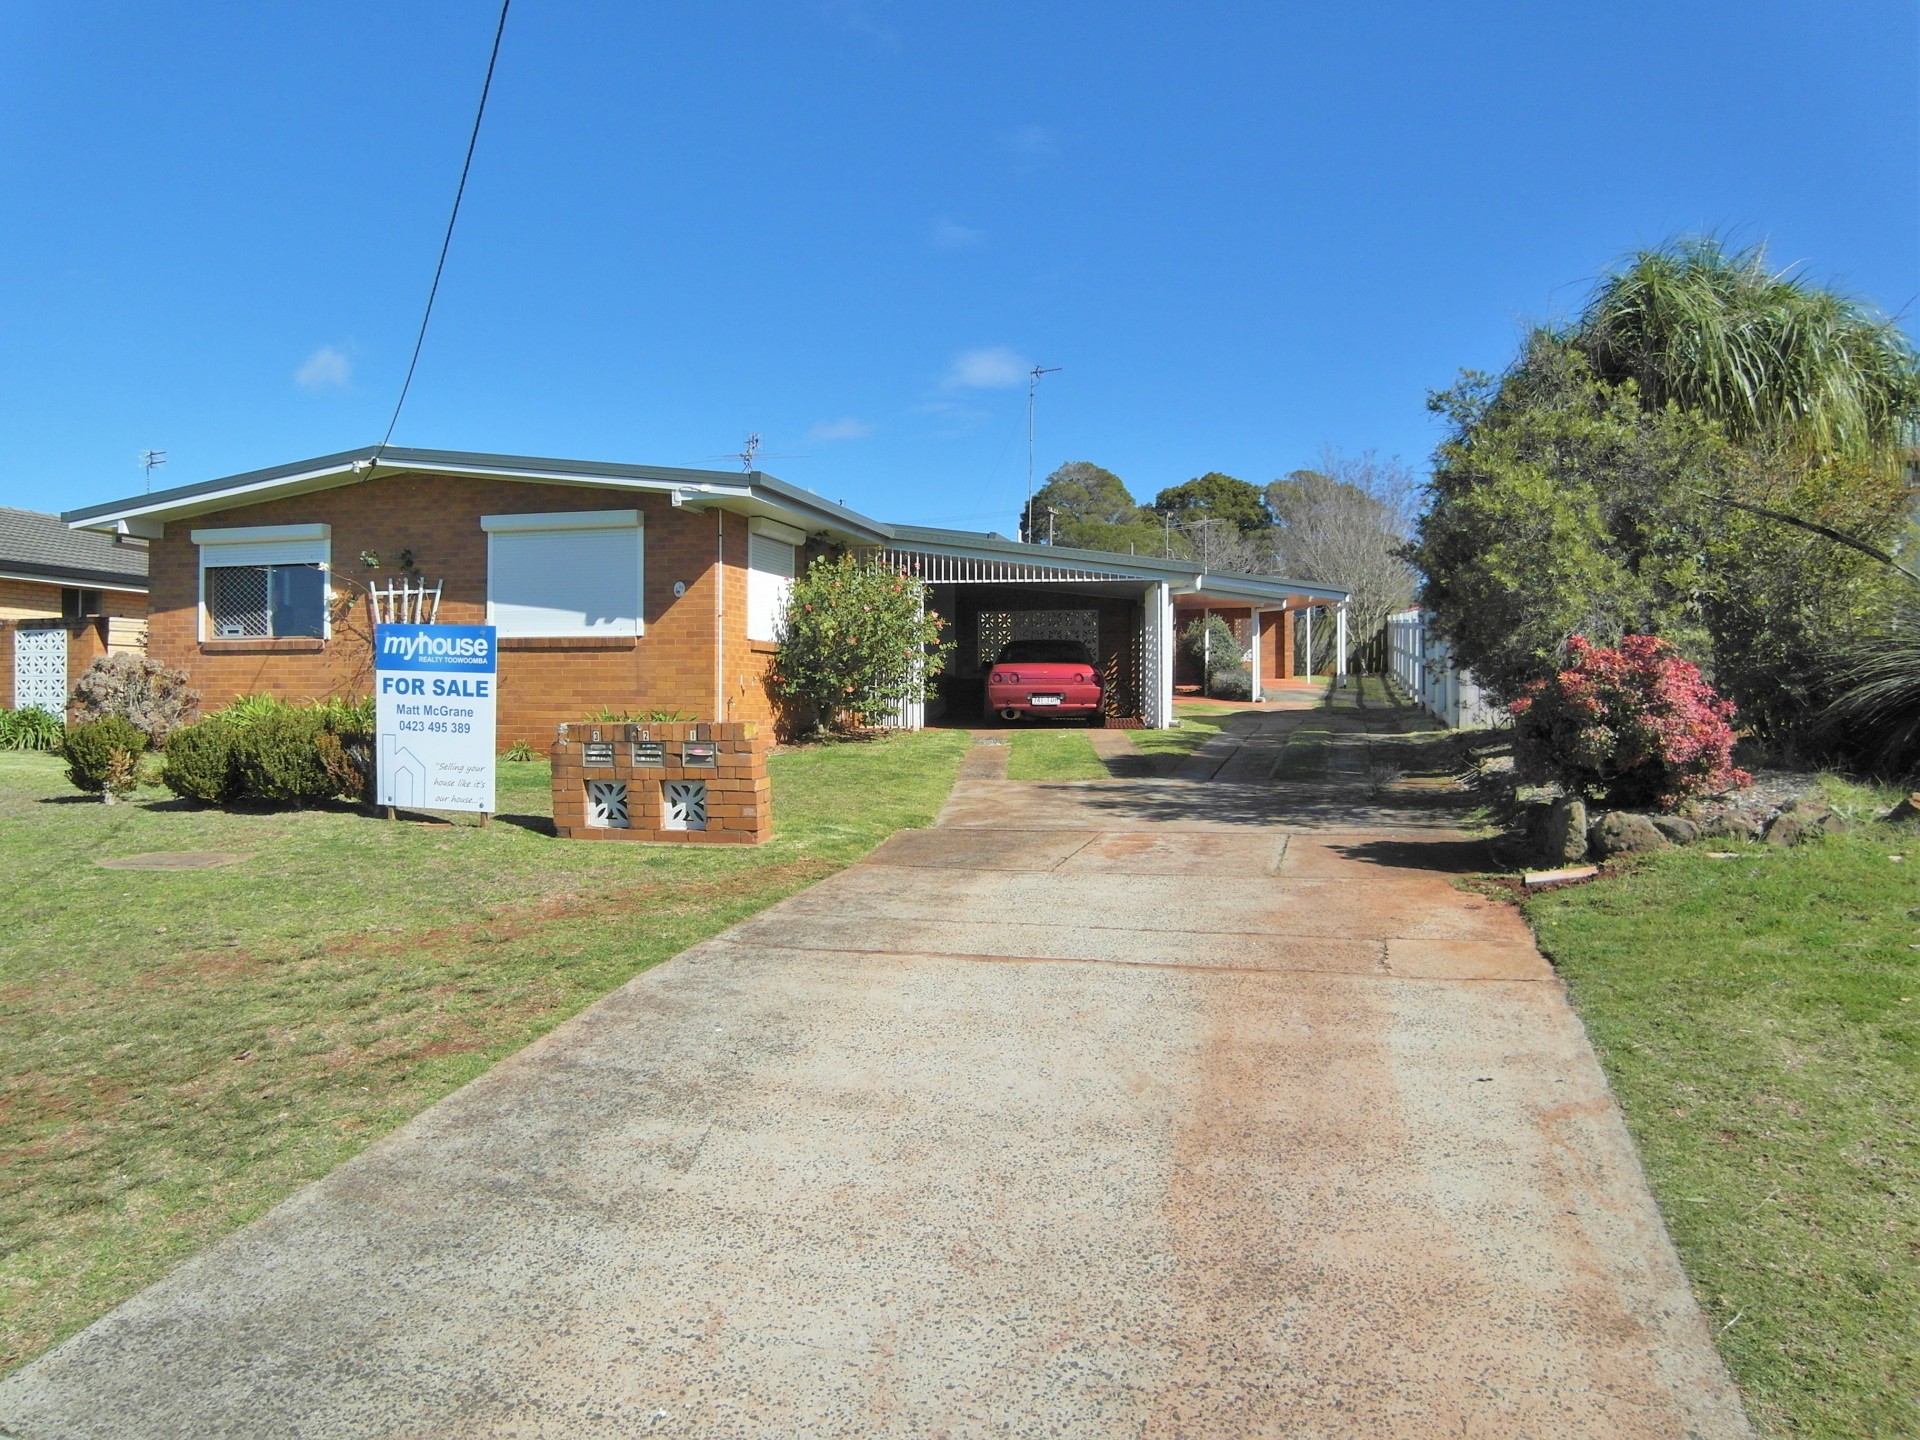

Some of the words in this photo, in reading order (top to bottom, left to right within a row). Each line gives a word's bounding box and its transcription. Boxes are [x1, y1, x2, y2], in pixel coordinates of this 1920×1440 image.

[383, 631, 489, 661] myhouse
[444, 657, 488, 665] TOOWOOMBA
[382, 677, 426, 696] FOR
[432, 678, 489, 698] SALE
[396, 703, 420, 715] Matt
[423, 705, 474, 718] McGrane
[399, 720, 425, 732] 0423
[427, 721, 448, 733] 495
[450, 722, 471, 734] 389
[435, 762, 465, 774] "Selling
[465, 765, 486, 774] your
[433, 778, 455, 787] house
[457, 779, 471, 788] like
[473, 780, 486, 789] it's
